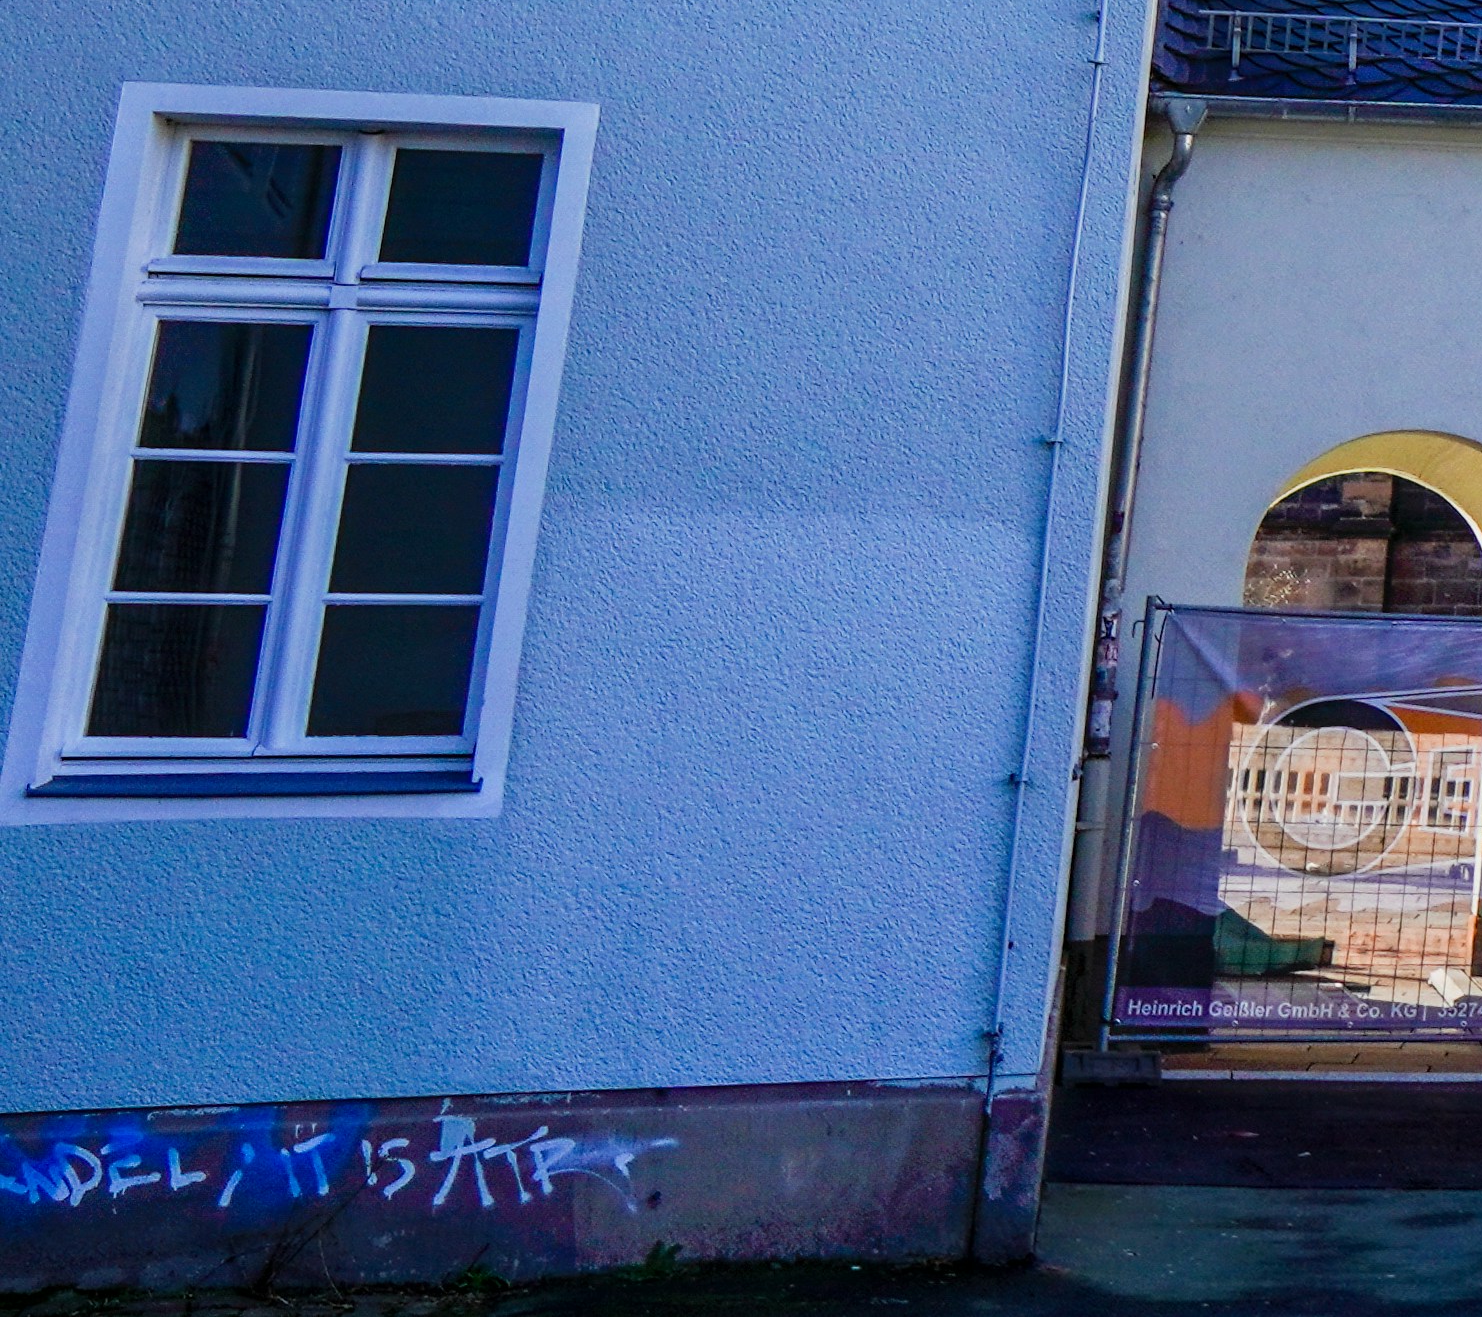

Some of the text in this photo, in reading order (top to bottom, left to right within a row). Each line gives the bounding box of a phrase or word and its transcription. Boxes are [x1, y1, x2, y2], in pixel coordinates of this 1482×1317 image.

[1128, 999, 1202, 1017] Heinrich
[1209, 1000, 1273, 1018] Geißler
[1277, 1002, 1333, 1019] GmbH
[1340, 1003, 1351, 1018] &
[1357, 1003, 1385, 1018] Co.
[1391, 1003, 1419, 1018] KG
